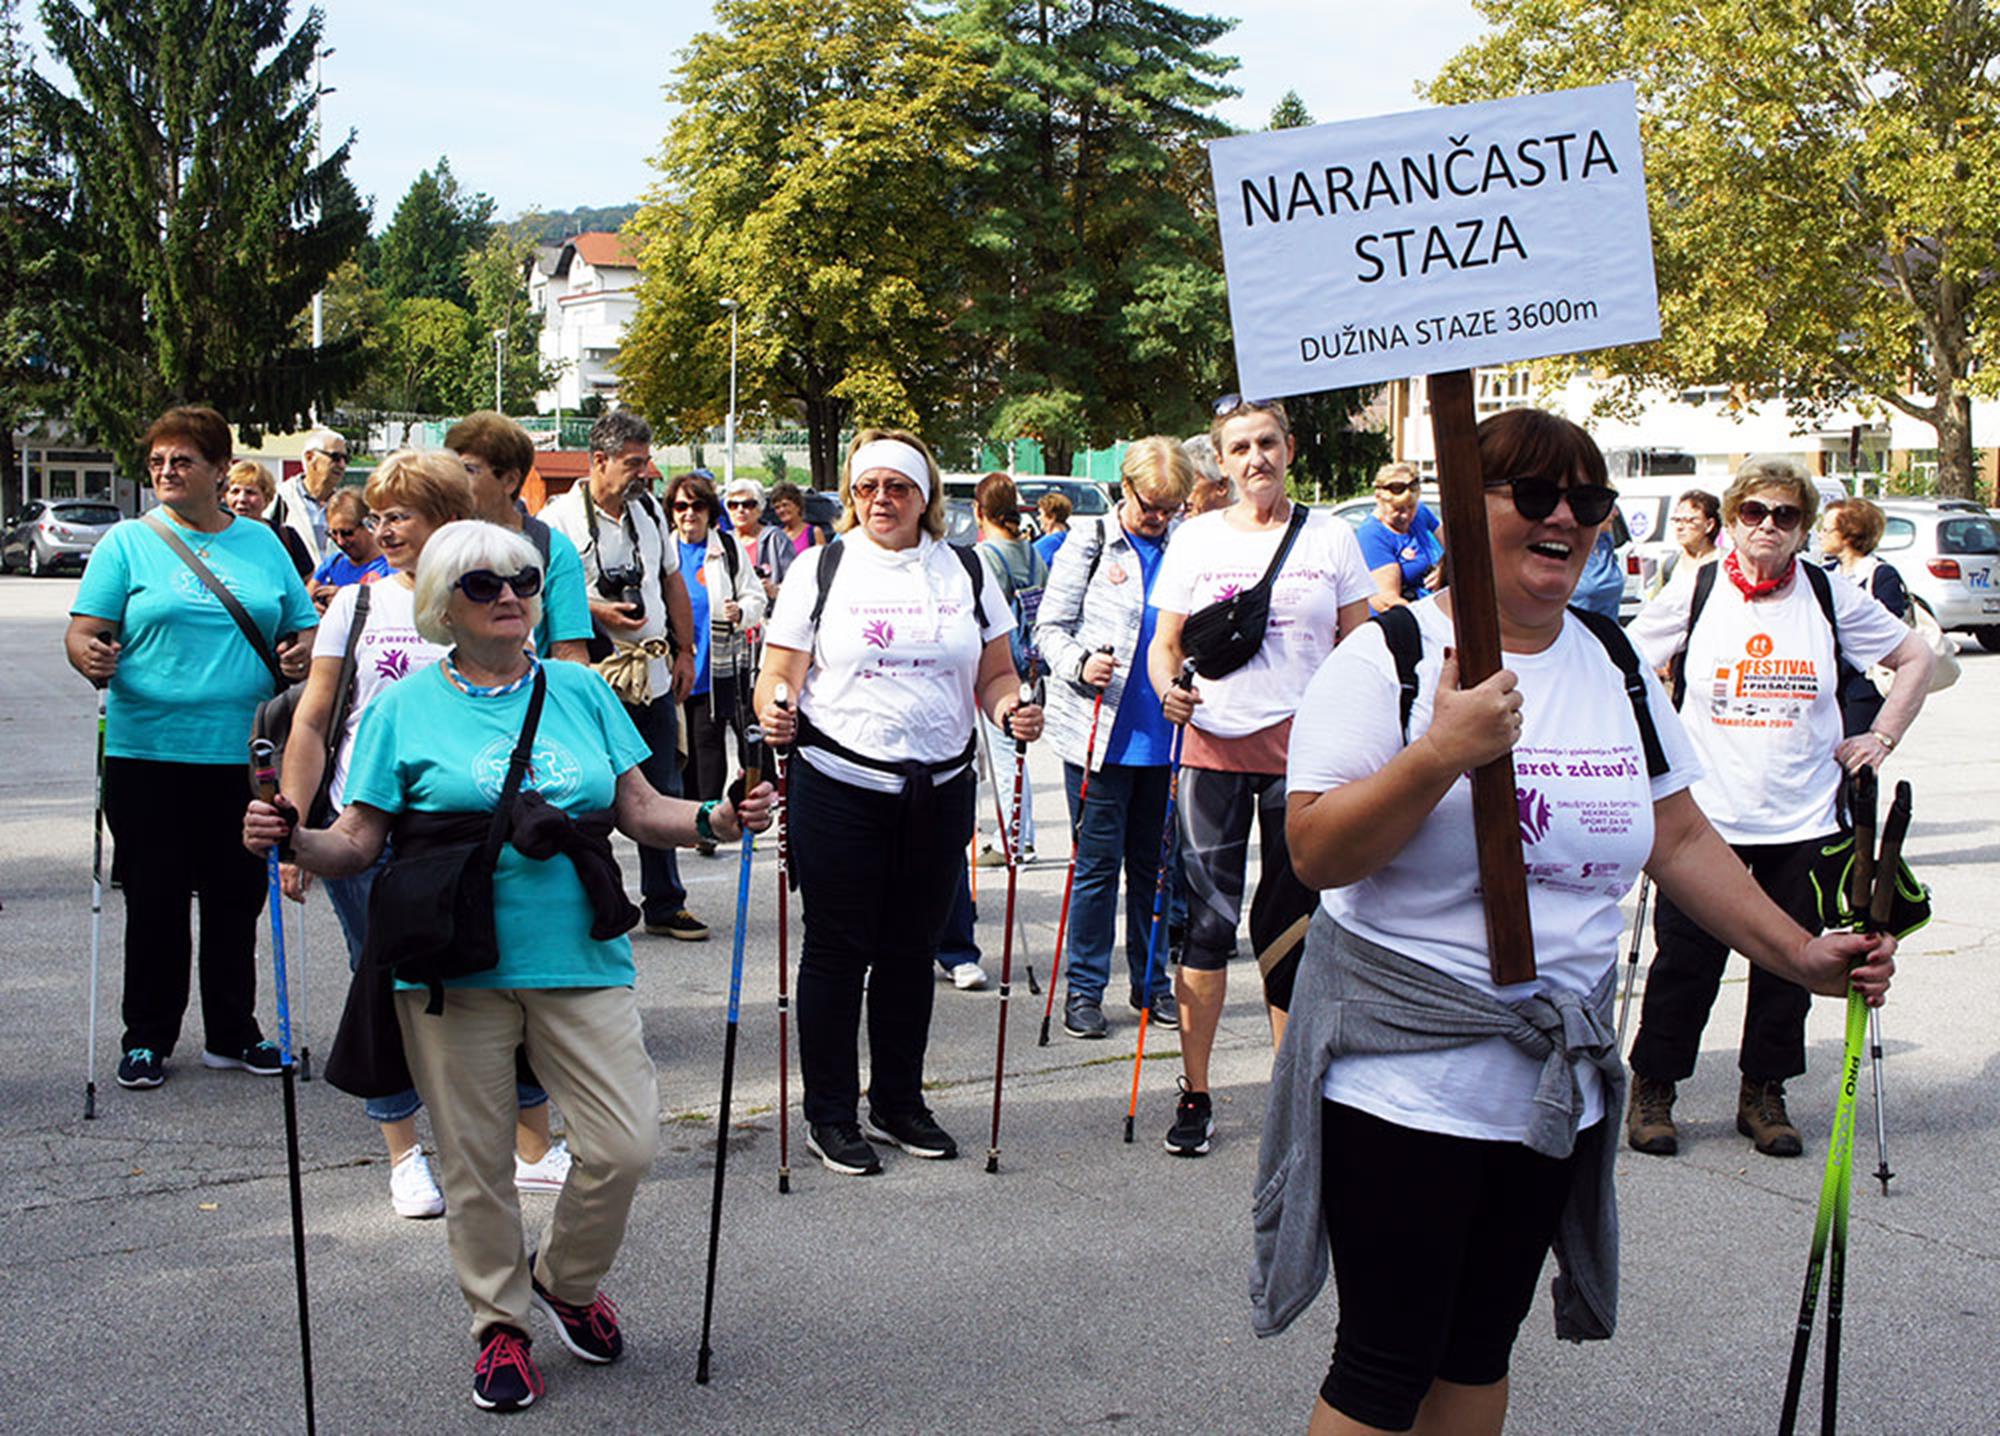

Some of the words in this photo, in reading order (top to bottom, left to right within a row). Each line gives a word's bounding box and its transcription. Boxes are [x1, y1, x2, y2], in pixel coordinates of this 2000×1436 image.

[1240, 129, 1619, 226] NARANČASTA
[1354, 215, 1528, 283] STAZA
[1300, 324, 1409, 362] DUŽINA
[1416, 310, 1498, 345] STAZE
[1506, 297, 1599, 331] 3600m
[1744, 659, 1817, 677] FESTIVAL
[1516, 761, 1563, 777] sret
[1845, 1055, 1860, 1097] PRO
